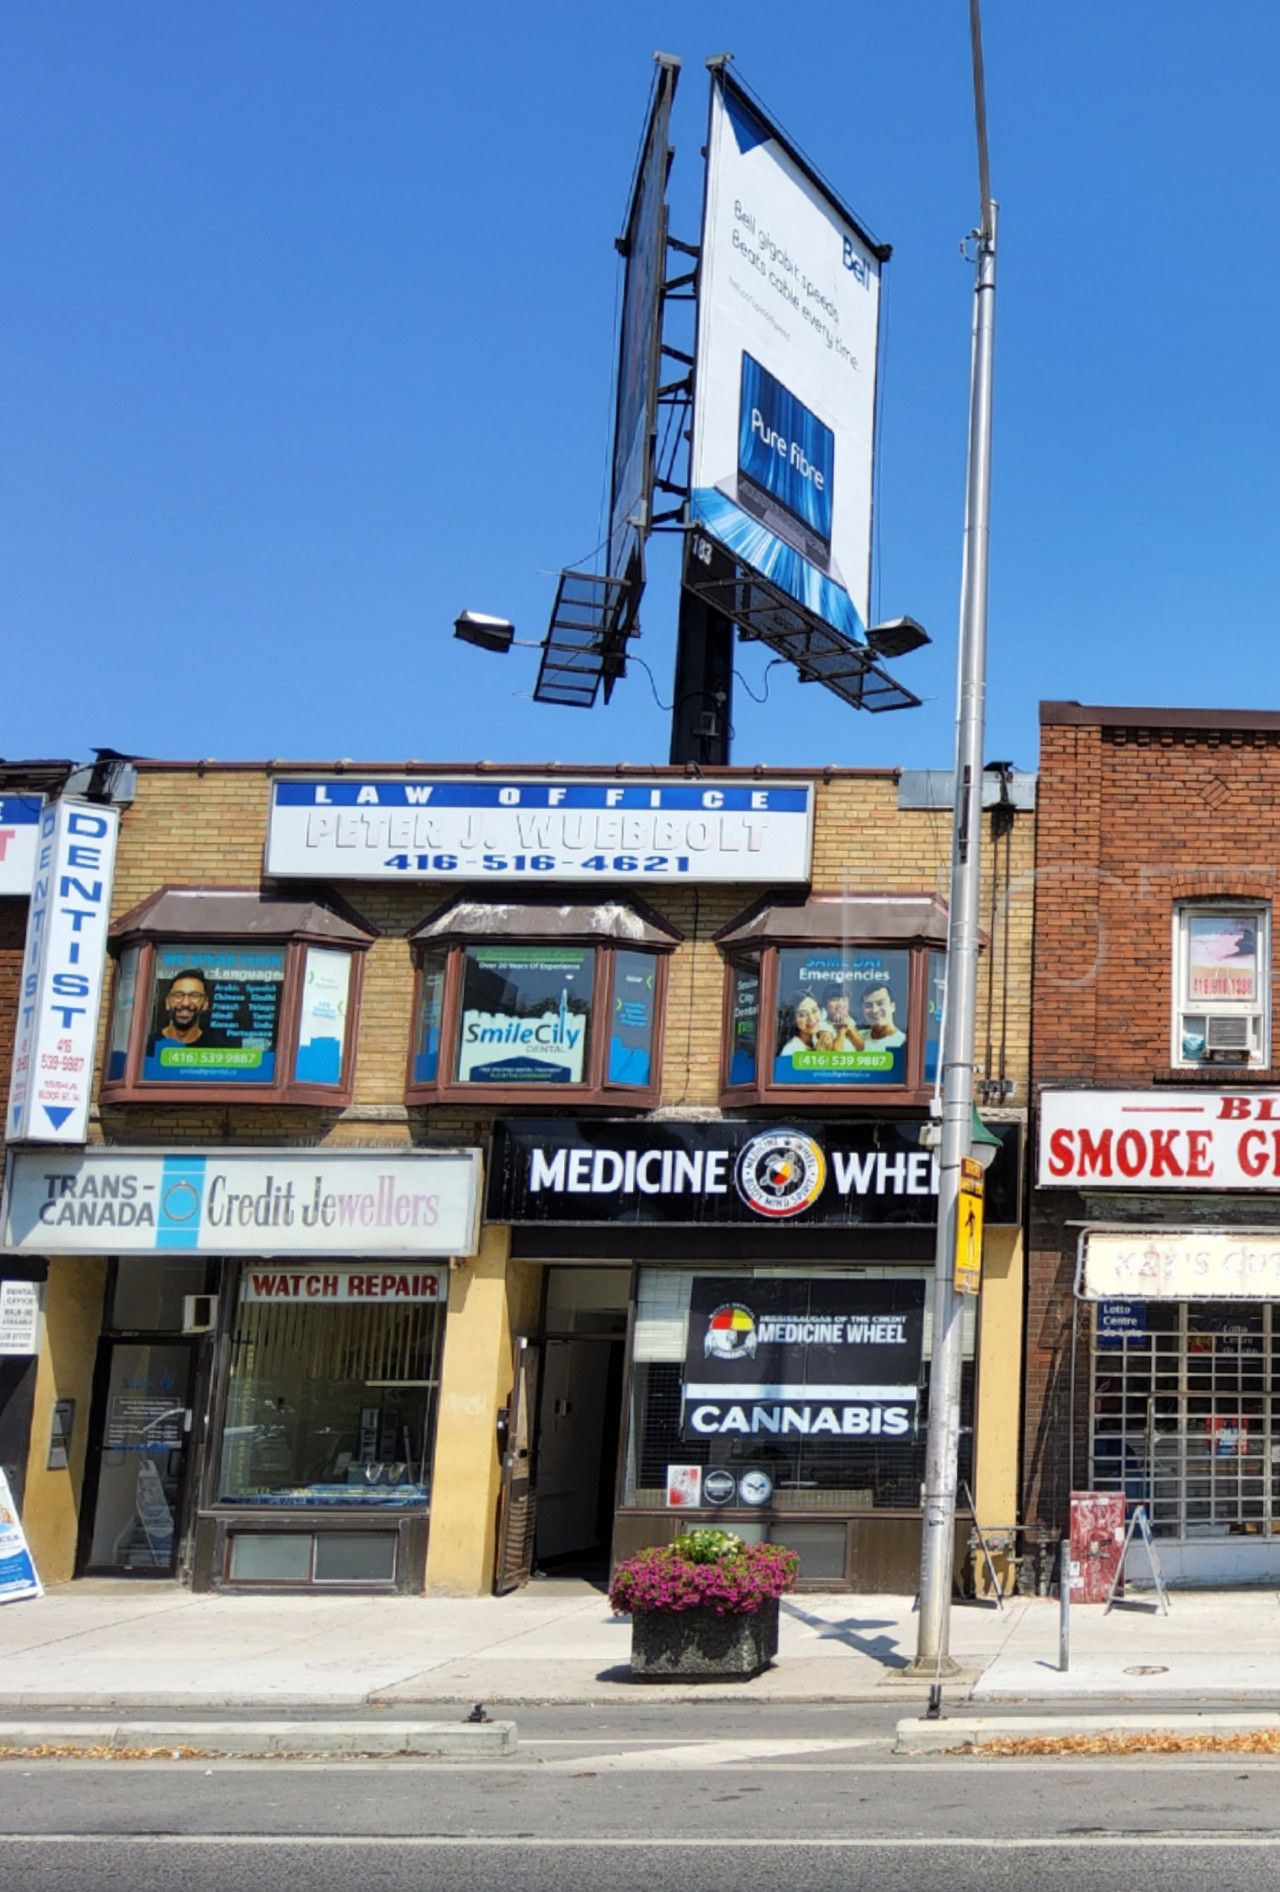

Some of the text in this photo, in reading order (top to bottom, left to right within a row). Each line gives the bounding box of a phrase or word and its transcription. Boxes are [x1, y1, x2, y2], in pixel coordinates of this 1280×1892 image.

[734, 199, 756, 235] Bell
[758, 232, 800, 281] gigabit
[843, 234, 871, 292] Bell
[732, 229, 766, 276] Beats
[769, 271, 800, 311] cable
[801, 306, 833, 349] every
[751, 408, 825, 491] Pure fibre
[314, 785, 770, 809] LAW OFFICE
[306, 811, 769, 853] PETER J. WUEBBOLT
[383, 853, 692, 873] 416-516-4621
[51, 812, 108, 1029] DENTIST
[215, 967, 284, 981] Language
[799, 967, 891, 984] Emergencies
[57, 1039, 73, 1054] 416
[168, 1051, 257, 1064] (416) 539 9887
[40, 1054, 85, 1074] 539-9887
[798, 1054, 887, 1067] (416) 539 9887
[1047, 1128, 1216, 1178] SMOKE
[529, 1148, 730, 1194] MEDICINE
[834, 1151, 940, 1195] WHE
[207, 1175, 440, 1228] Credit Jewellers
[39, 1202, 156, 1228] CANADA
[252, 1274, 438, 1298] WATCH REPAIR
[834, 1315, 849, 1323] OF
[850, 1315, 870, 1323] THE
[872, 1315, 908, 1323] CREDIT
[1103, 1304, 1131, 1315] Lotto
[1103, 1315, 1138, 1326] Centre
[846, 1324, 908, 1344] WHEEL
[690, 1406, 910, 1435] CANNABIS
